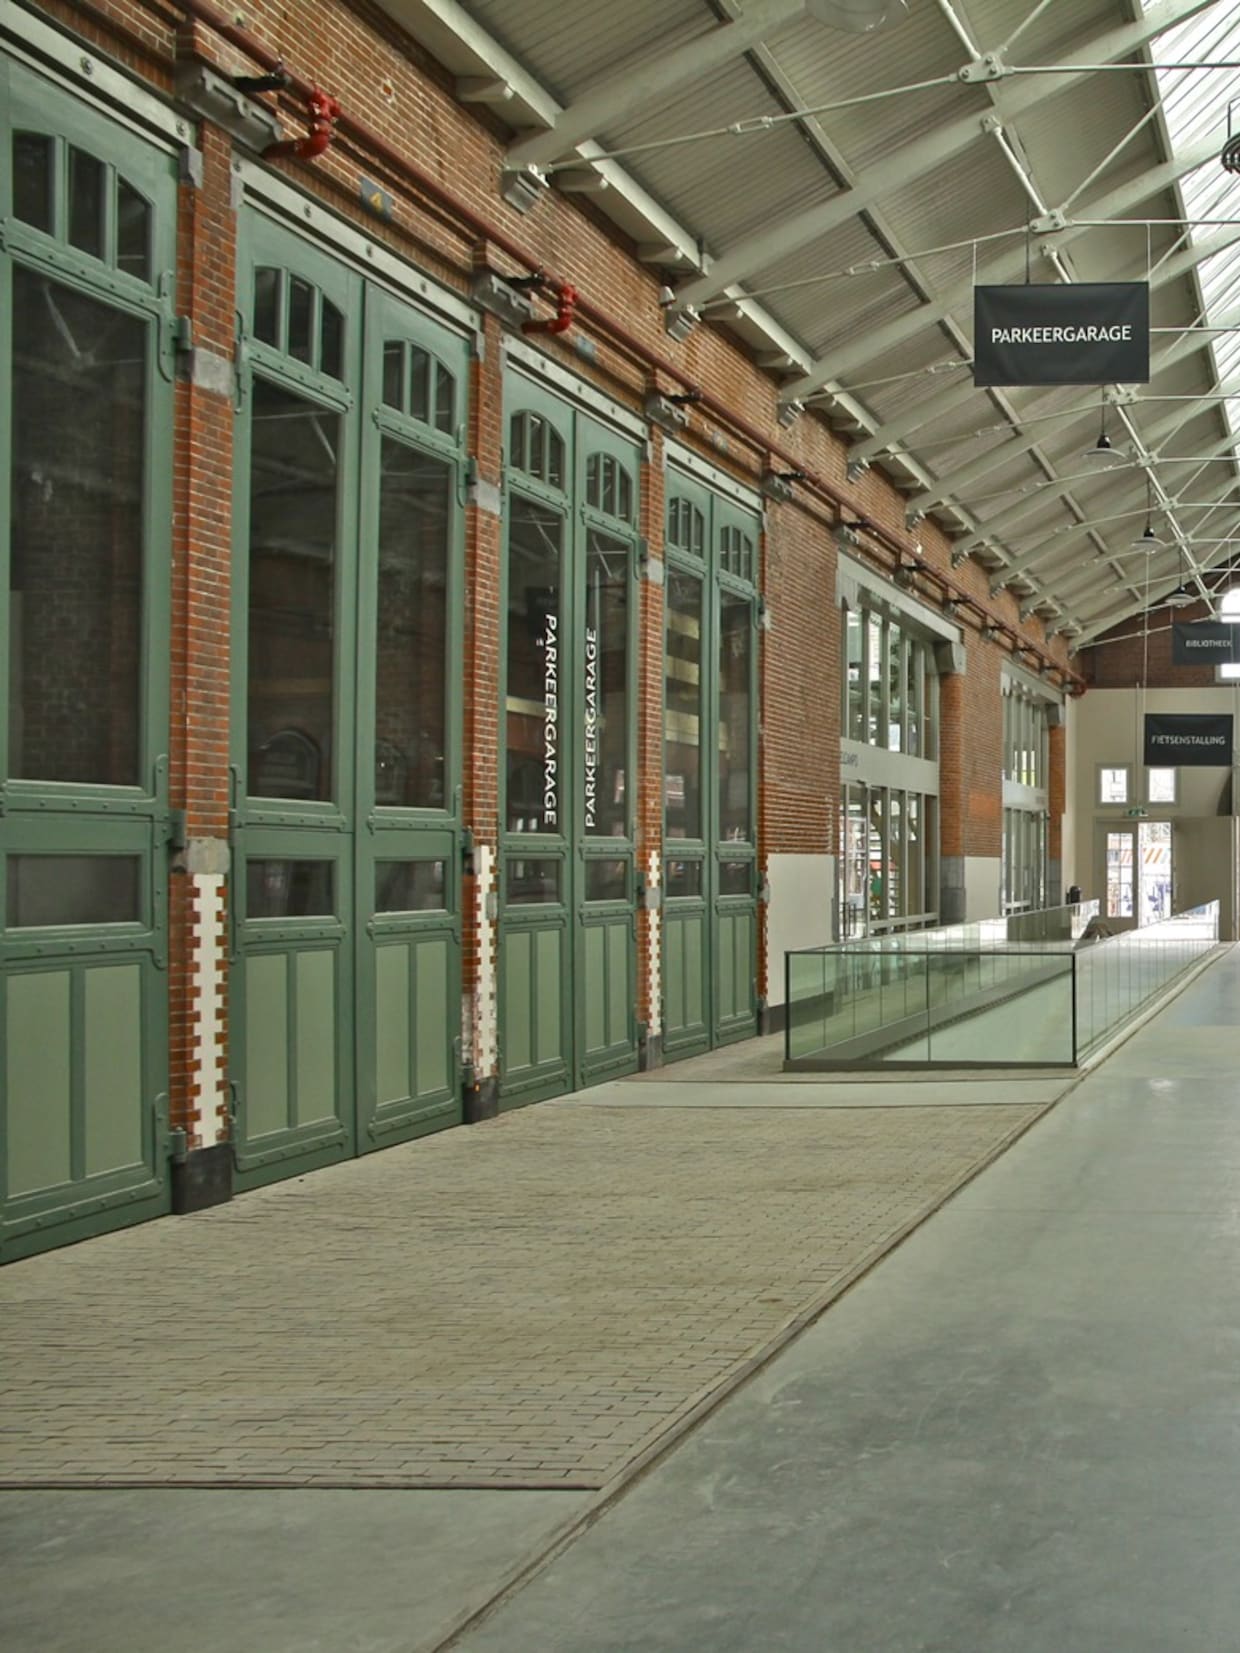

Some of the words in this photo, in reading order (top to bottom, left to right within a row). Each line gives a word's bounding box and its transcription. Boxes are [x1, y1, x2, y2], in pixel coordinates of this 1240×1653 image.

[991, 325, 1132, 343] PARKEERGARAGE
[1185, 640, 1233, 648] BIBLIOTHEEK
[544, 614, 558, 825] PARKEERGARAGE
[585, 628, 597, 827] PARKEERGARAGE
[1151, 735, 1225, 745] FIETSENSTALLING
